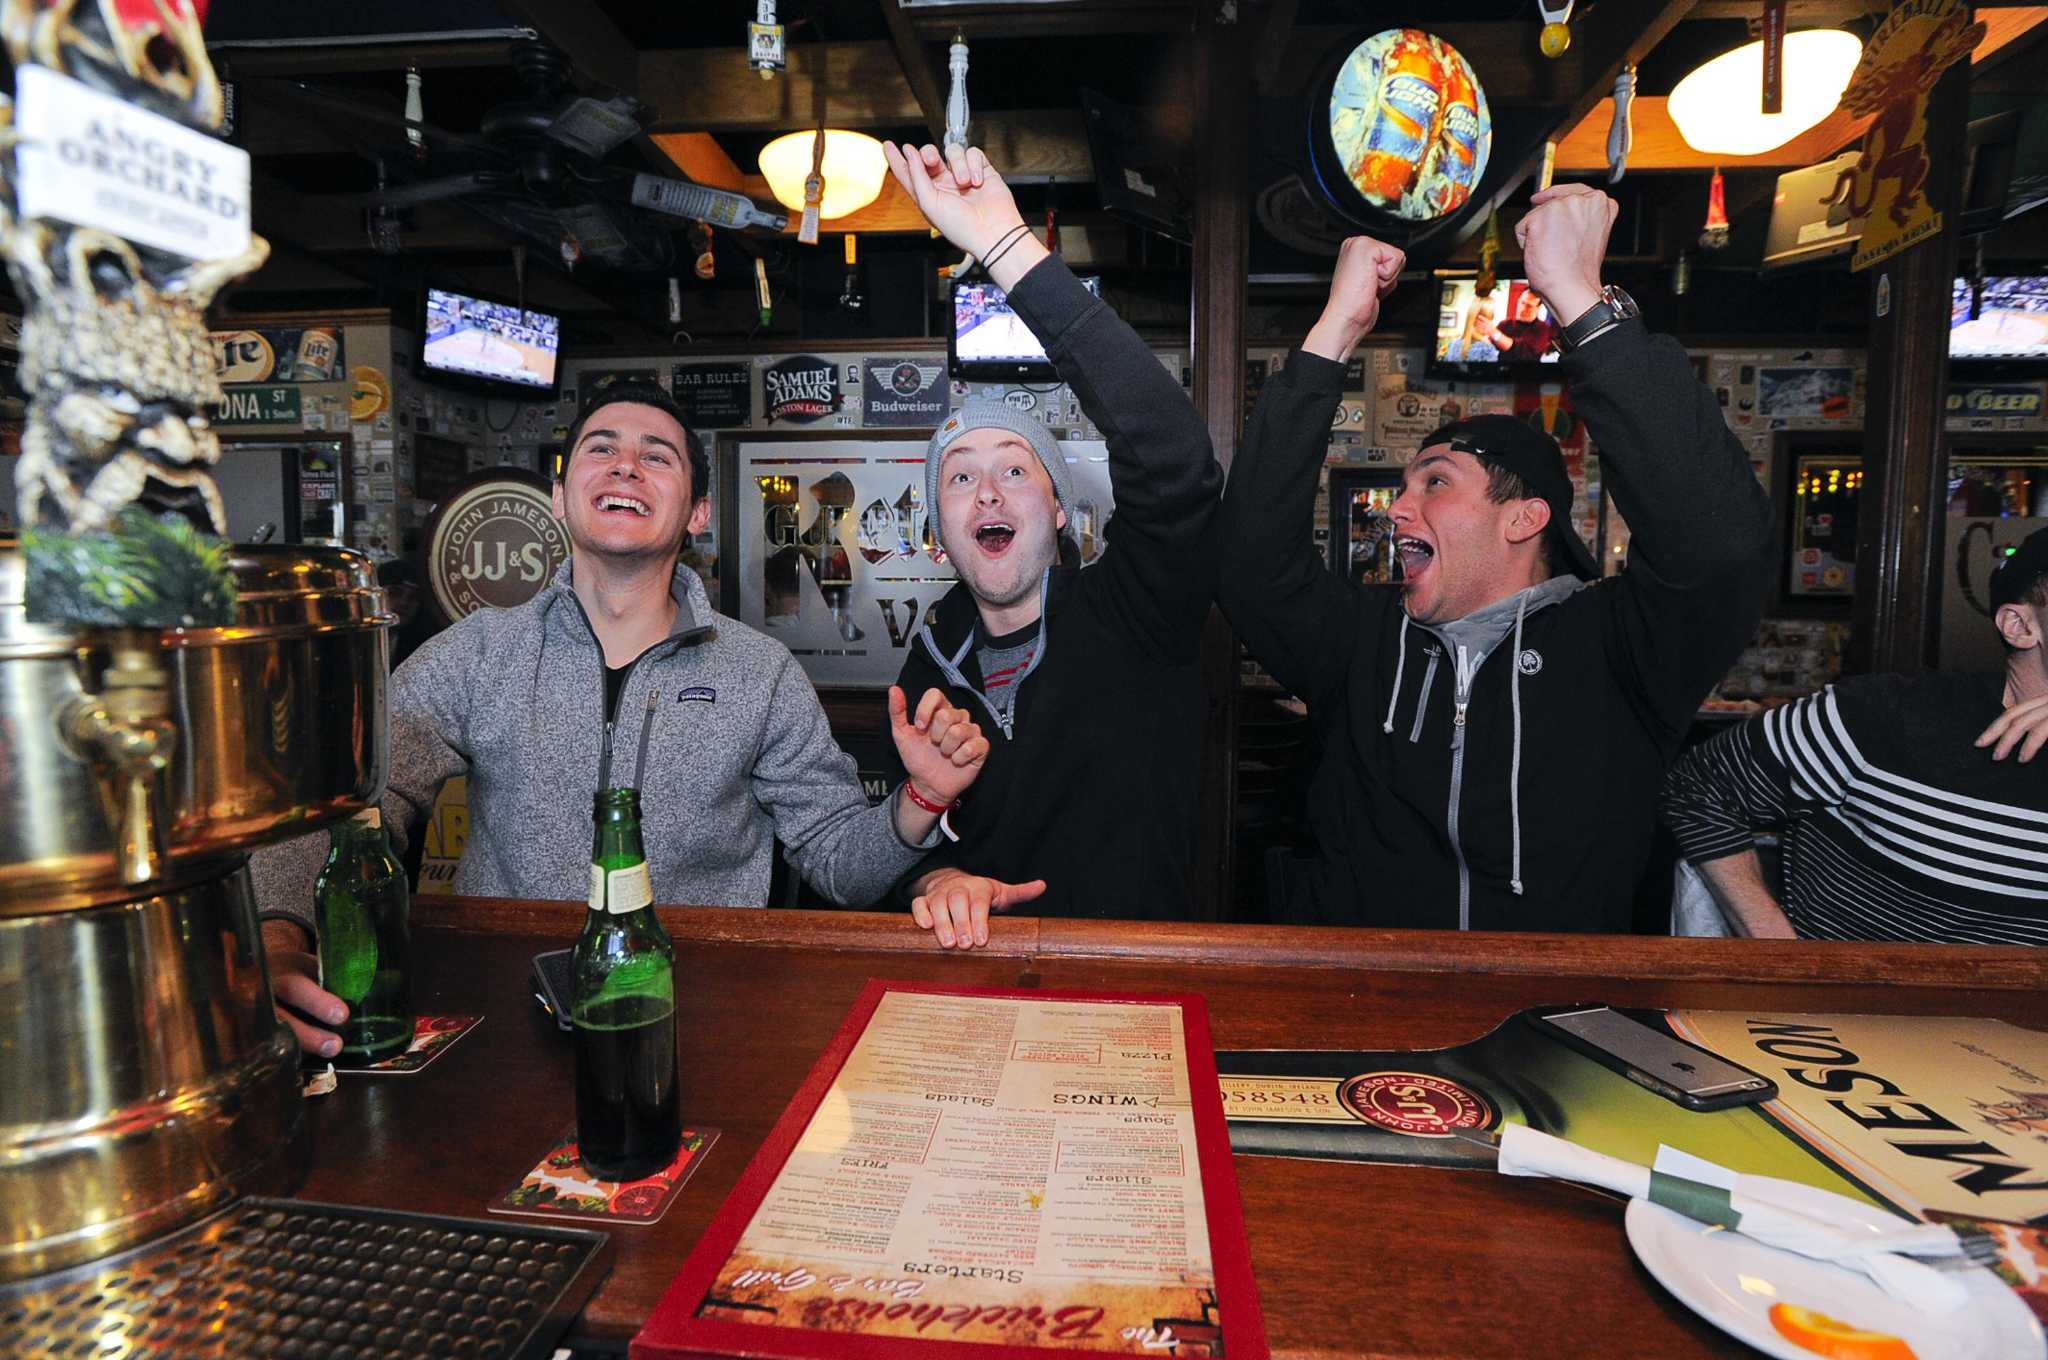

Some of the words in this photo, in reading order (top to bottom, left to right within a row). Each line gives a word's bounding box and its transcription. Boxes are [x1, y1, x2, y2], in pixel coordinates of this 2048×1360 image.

[1385, 89, 1439, 113] LIGHT
[1387, 78, 1440, 104] BUD
[84, 114, 220, 184] ANGRY
[58, 136, 240, 220] ORCHARD
[675, 373, 701, 385] BAR
[766, 367, 837, 391] SAMUEL
[219, 392, 260, 420] ONA
[773, 384, 832, 406] ADAMS
[871, 399, 943, 412] Budweiser
[448, 507, 484, 557] JOHN
[490, 500, 563, 558] JAMESON
[461, 541, 545, 582] JJ&S
[1120, 1052, 1173, 1062] Pizza
[923, 1093, 996, 1108] Salads
[1052, 1093, 1138, 1108] WINGS
[1388, 1085, 1441, 1126] JJ&S
[1123, 1116, 1175, 1127] Soups
[839, 1157, 889, 1171] FRIES
[1086, 1175, 1152, 1186] Sliders
[731, 1267, 817, 1293] Grill
[902, 1262, 1026, 1285] Starters
[862, 1278, 927, 1301] Bar
[801, 1298, 1105, 1341] Brickhouse
[1121, 1326, 1181, 1349] The
